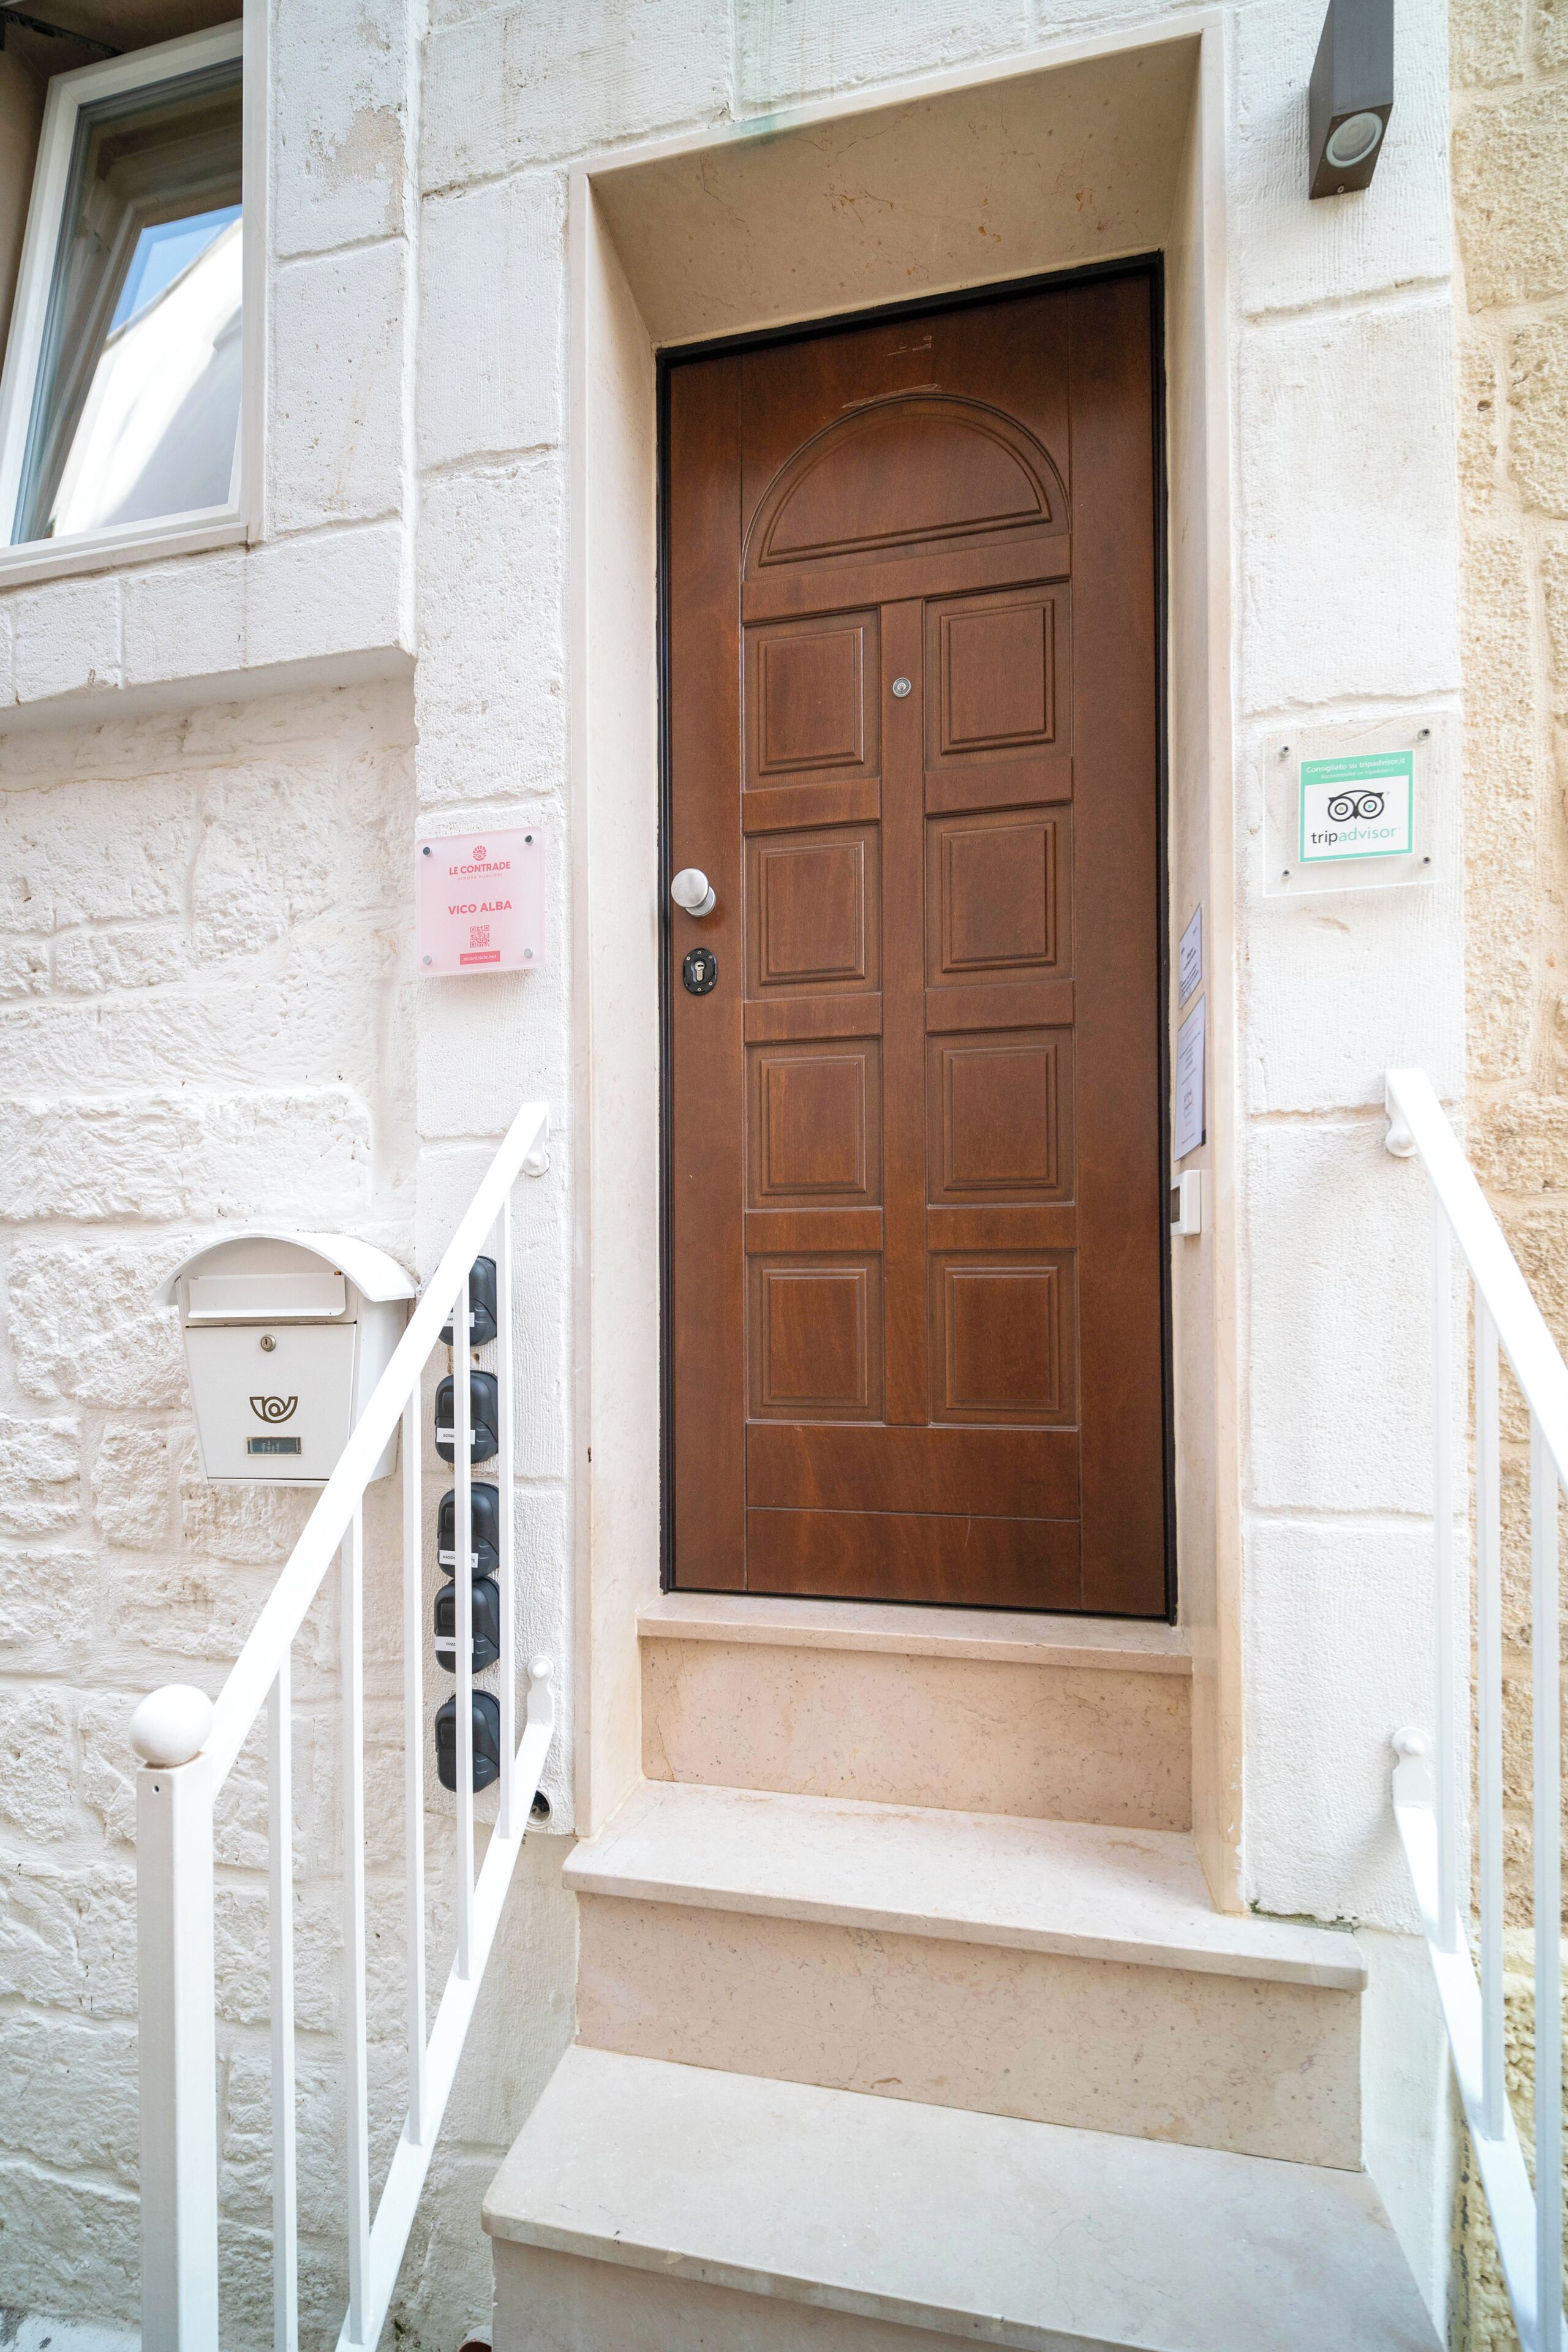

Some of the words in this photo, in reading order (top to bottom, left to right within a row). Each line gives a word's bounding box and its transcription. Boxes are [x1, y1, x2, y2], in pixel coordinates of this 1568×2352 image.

[1305, 763, 1347, 774] Consigliato
[1359, 757, 1406, 769] tripadvisor.it
[1311, 827, 1397, 846] tripadvisor
[449, 867, 459, 875] LE
[460, 861, 511, 874] CONTRADE
[448, 903, 477, 915] VICO
[480, 900, 512, 912] ALBA
